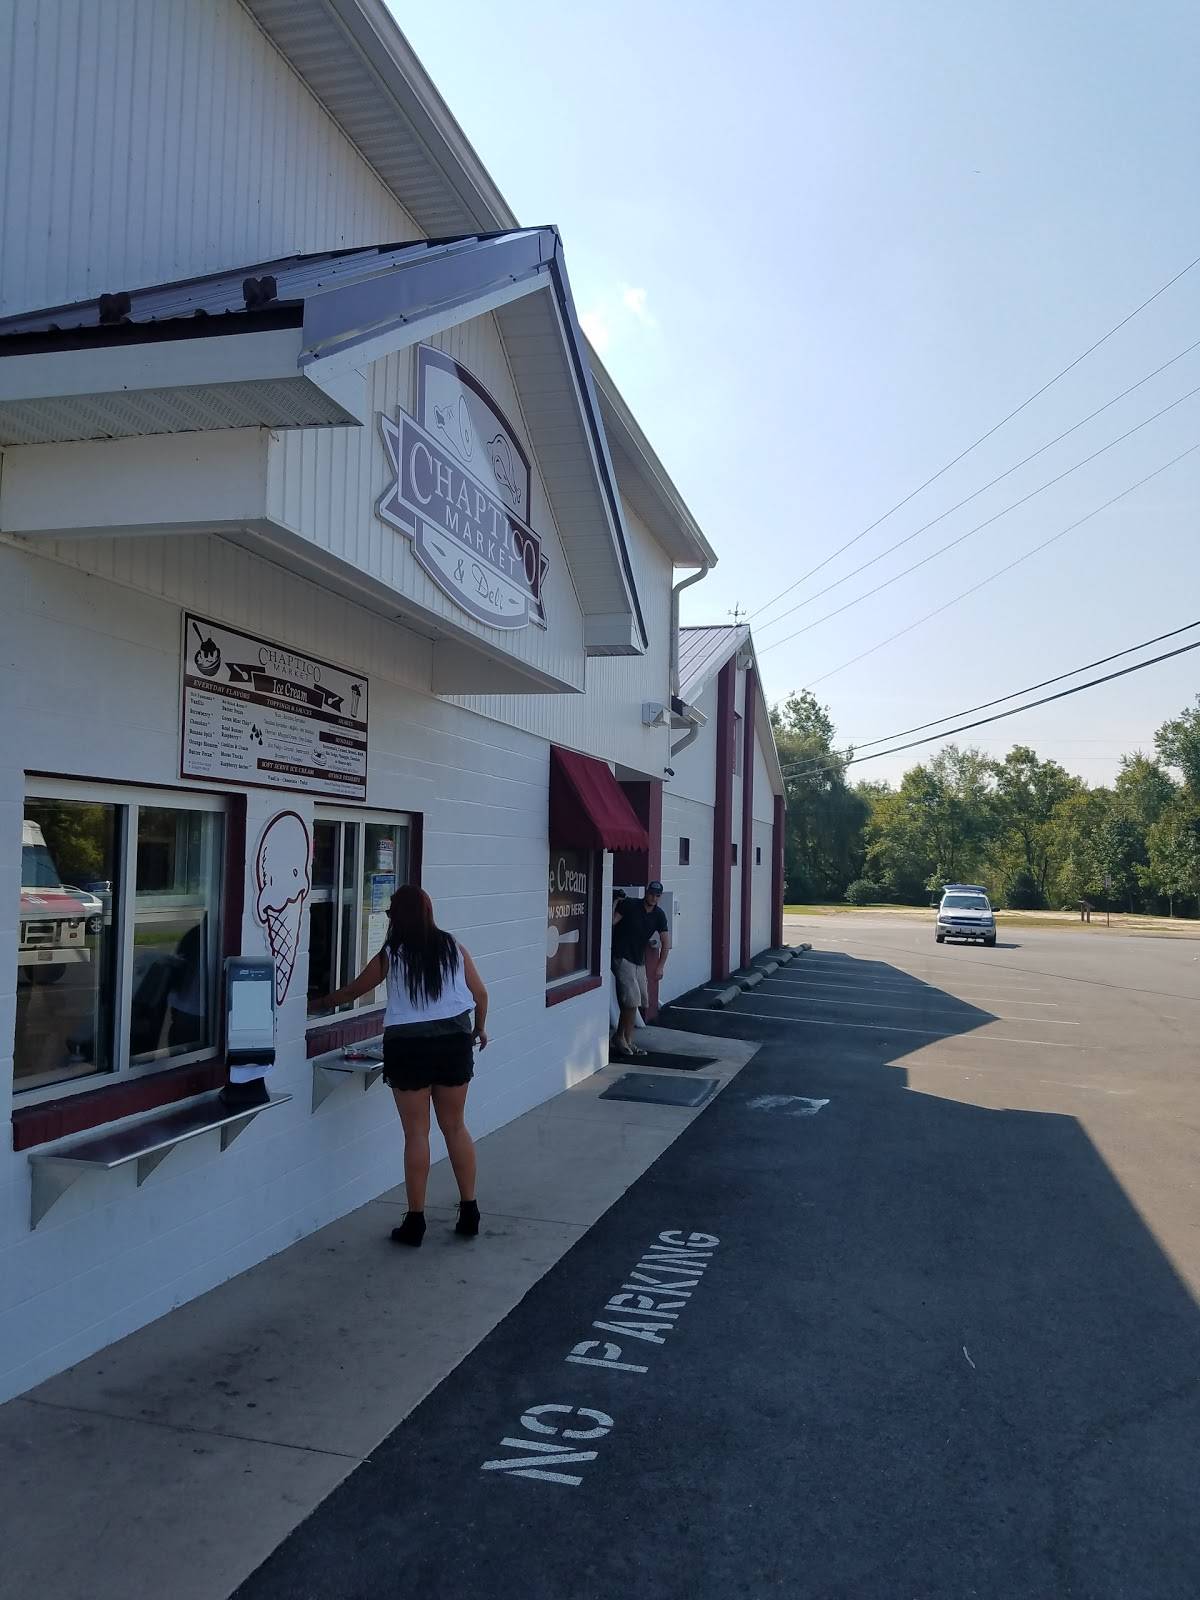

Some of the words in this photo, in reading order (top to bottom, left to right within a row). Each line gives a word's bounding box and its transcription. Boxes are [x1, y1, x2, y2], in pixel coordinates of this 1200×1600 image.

[409, 441, 536, 586] CHAPTICO
[446, 506, 515, 576] MARKET
[453, 559, 465, 584] &
[472, 563, 505, 610] Deli
[258, 646, 321, 683] CHAPTICO
[273, 662, 310, 681] MARKET
[193, 679, 225, 695] EVERYDAY
[273, 679, 284, 695] Ice
[285, 682, 308, 703] Cream
[558, 857, 587, 895] Cream
[556, 904, 571, 919] SOLD
[571, 903, 585, 917] HERE
[480, 1403, 615, 1486] NO
[564, 1229, 721, 1373] PARKING
